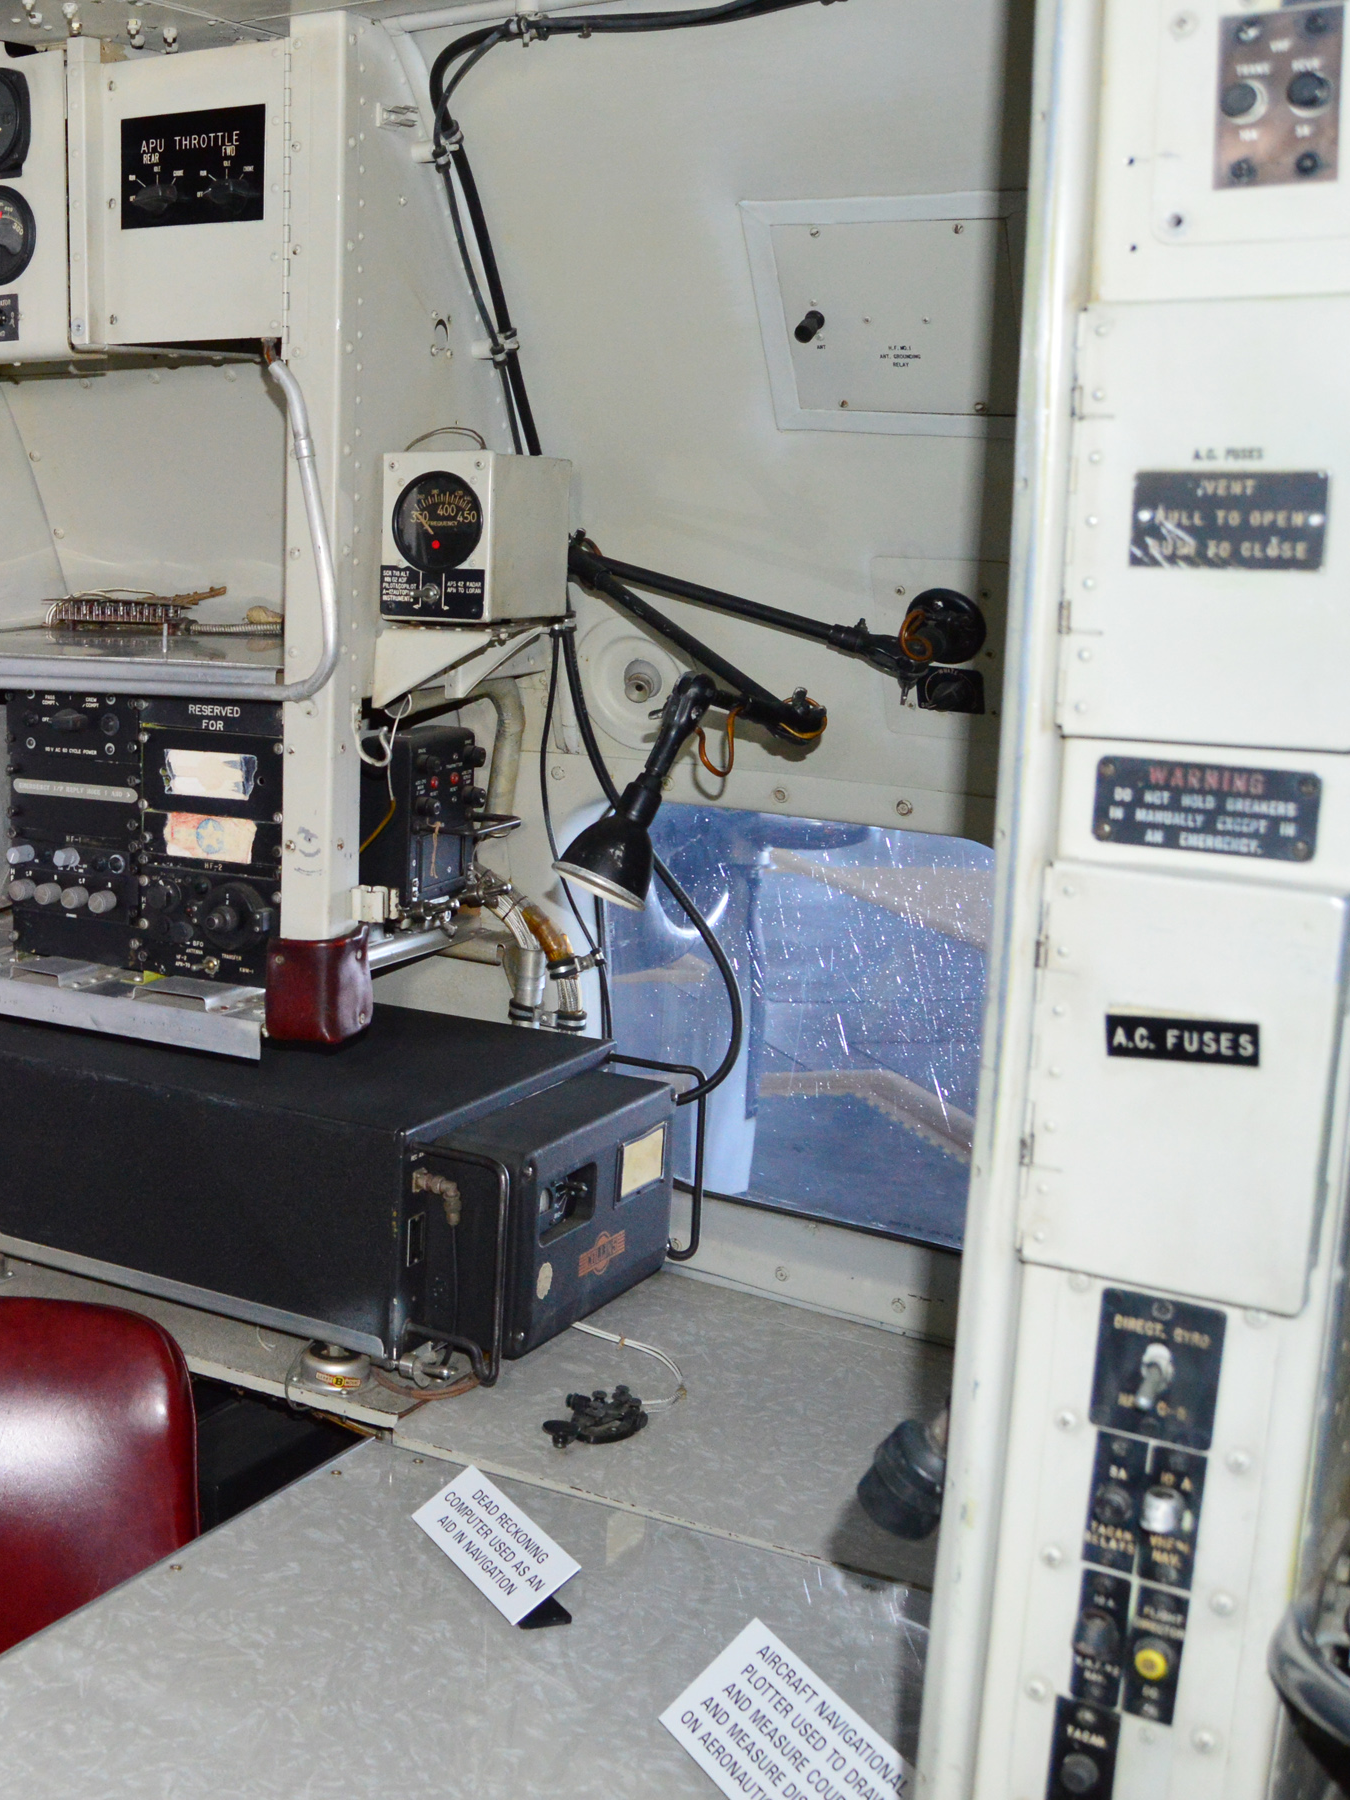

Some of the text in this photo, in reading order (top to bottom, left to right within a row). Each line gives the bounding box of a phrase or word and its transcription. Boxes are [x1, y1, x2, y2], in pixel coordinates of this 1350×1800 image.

[140, 131, 240, 154] APU THROTTLE
[222, 146, 236, 157] FWD
[143, 153, 160, 165] REAR
[12, 222, 24, 236] 300
[1202, 478, 1257, 496] VENT
[437, 504, 456, 516] 400
[457, 511, 477, 523] 450
[1216, 510, 1242, 527] TO
[1250, 510, 1305, 528] OPEN
[1207, 540, 1231, 558] TO
[1241, 540, 1308, 560] CLOSE
[189, 704, 241, 718] RESERVED
[202, 720, 224, 731] FOR
[1149, 766, 1265, 796] WARNING
[1114, 786, 1298, 818] DO NOT HOLD BREAKERS
[1109, 806, 1296, 837] IN MANUALLY EXCEPT IN
[66, 835, 82, 843] HF-1
[1145, 829, 1164, 844] AN
[204, 863, 223, 871] HF-2
[1113, 1026, 1254, 1058] A.C. FUSES
[472, 1489, 549, 1564] DEAD RECKONING
[444, 1491, 546, 1592] COMPUTER USED AS AN
[437, 1515, 518, 1596] AID IN NAVIGATION
[680, 1710, 703, 1734] ON
[722, 1682, 752, 1712] AND
[749, 1709, 810, 1774] MEASURE
[740, 1663, 794, 1719] PLOTTER
[791, 1713, 827, 1753] USED
[825, 1749, 847, 1772] TO
[756, 1645, 908, 1798] AIRCRAFT NAVIGATIONAL
[700, 1696, 730, 1726] AND
[726, 1723, 786, 1788] MEASURE
